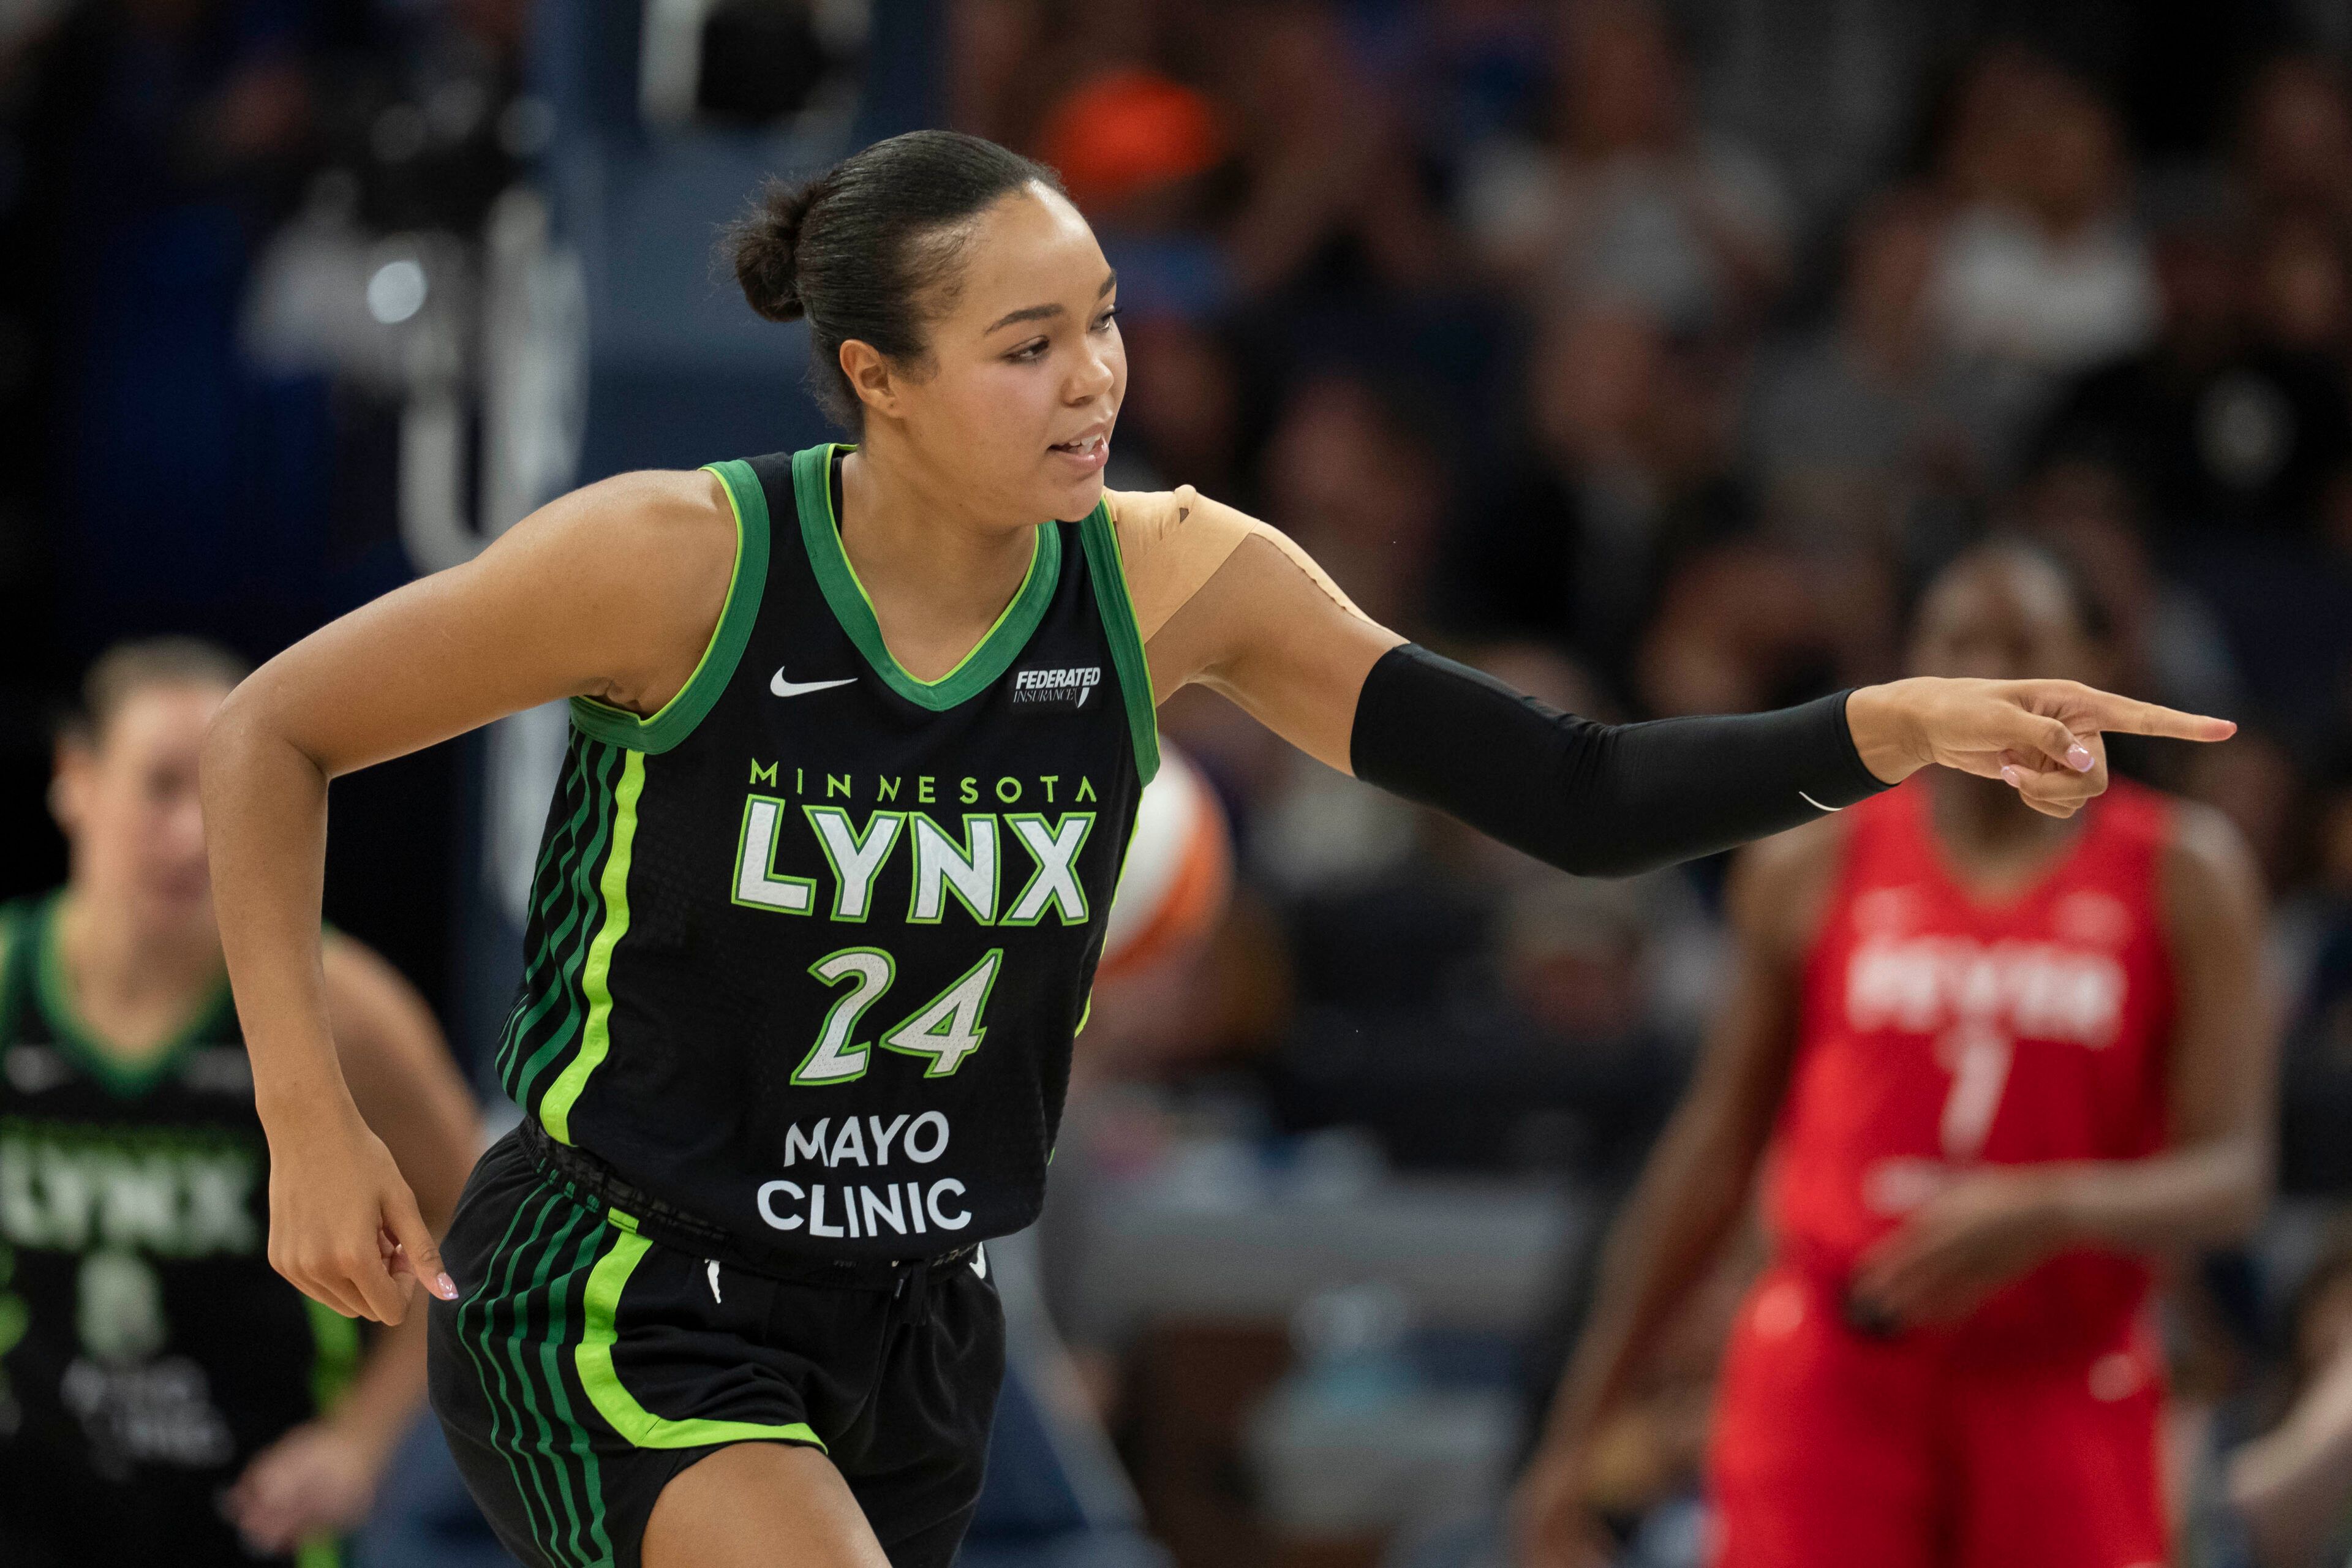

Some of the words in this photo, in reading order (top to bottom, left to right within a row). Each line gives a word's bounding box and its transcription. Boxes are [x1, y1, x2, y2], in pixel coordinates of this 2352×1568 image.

[1012, 687, 1074, 703] INSURANCE
[1016, 666, 1101, 690] FEDERATED
[748, 757, 1097, 805] MINNESOTA
[731, 793, 1097, 927] LYNX
[789, 946, 1004, 1086] 24
[783, 1110, 950, 1168] MAYO
[756, 1177, 973, 1238] CLINIC
